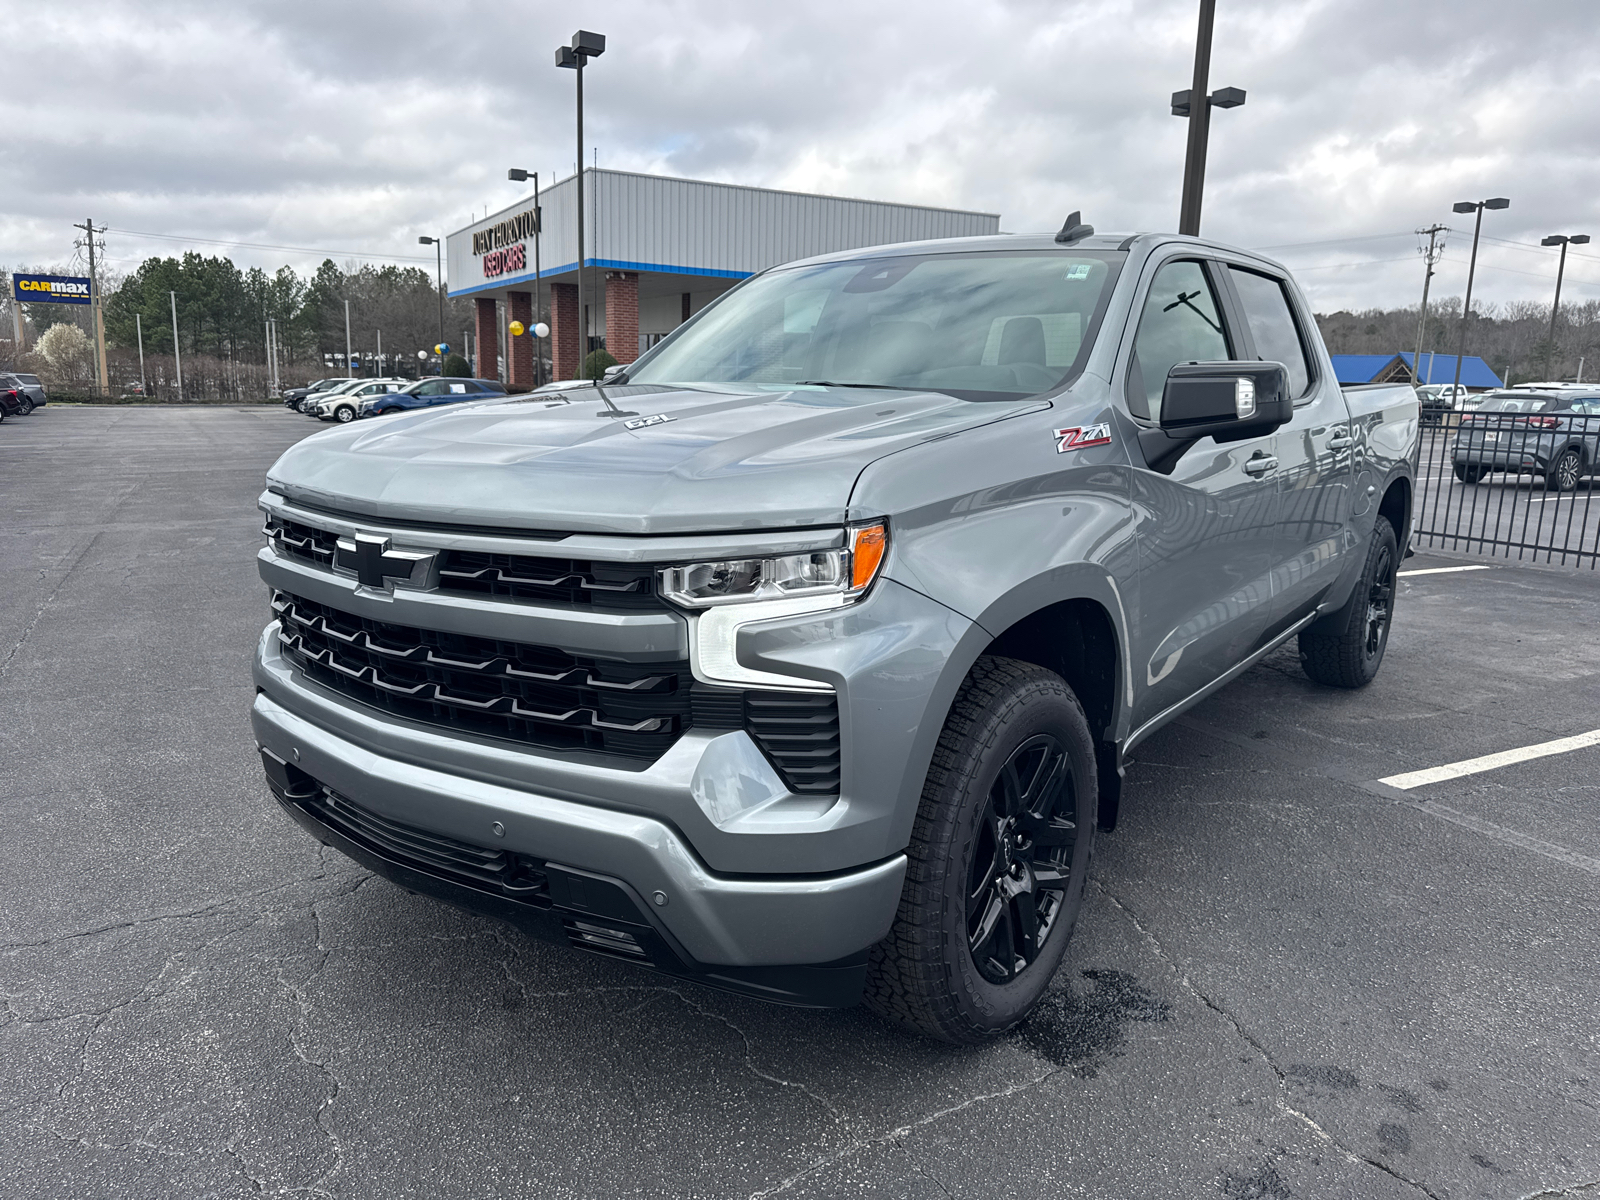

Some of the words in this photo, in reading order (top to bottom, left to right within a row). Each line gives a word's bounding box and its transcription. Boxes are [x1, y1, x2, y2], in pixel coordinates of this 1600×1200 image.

[472, 227, 493, 255] JOHN
[490, 206, 541, 249] THORNTON
[483, 251, 503, 278] USED
[502, 243, 526, 273] CARS
[1052, 422, 1112, 454] Z71
